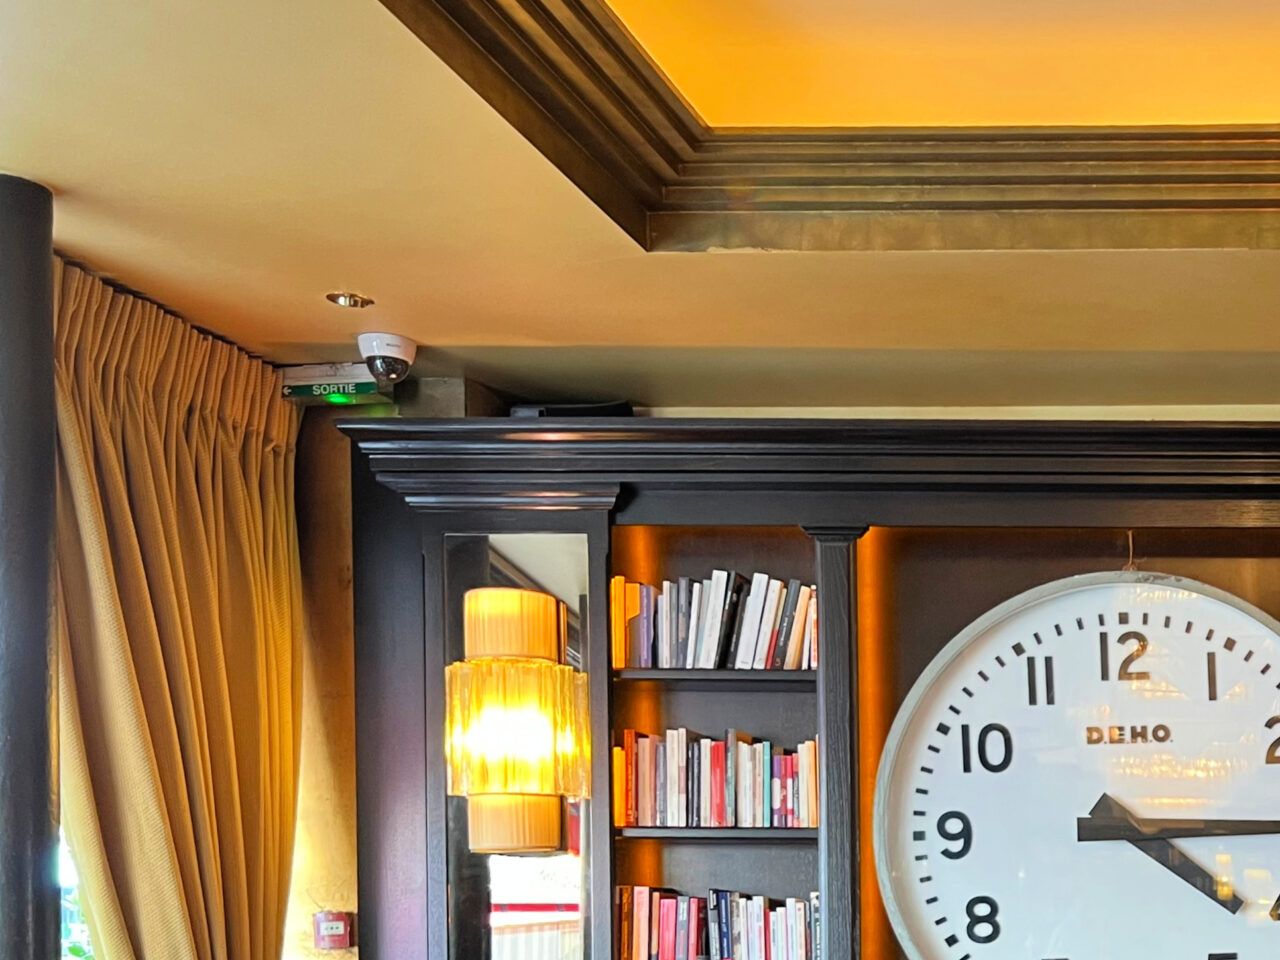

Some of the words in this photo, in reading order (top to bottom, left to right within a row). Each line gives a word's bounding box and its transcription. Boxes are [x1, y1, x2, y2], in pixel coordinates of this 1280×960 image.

[312, 383, 356, 395] SORTIE
[1026, 656, 1056, 706] 11
[1099, 630, 1151, 682] 12
[1206, 652, 1218, 701] 1
[959, 722, 1014, 773] 10
[936, 810, 973, 860] 9
[965, 895, 1001, 945] 8
